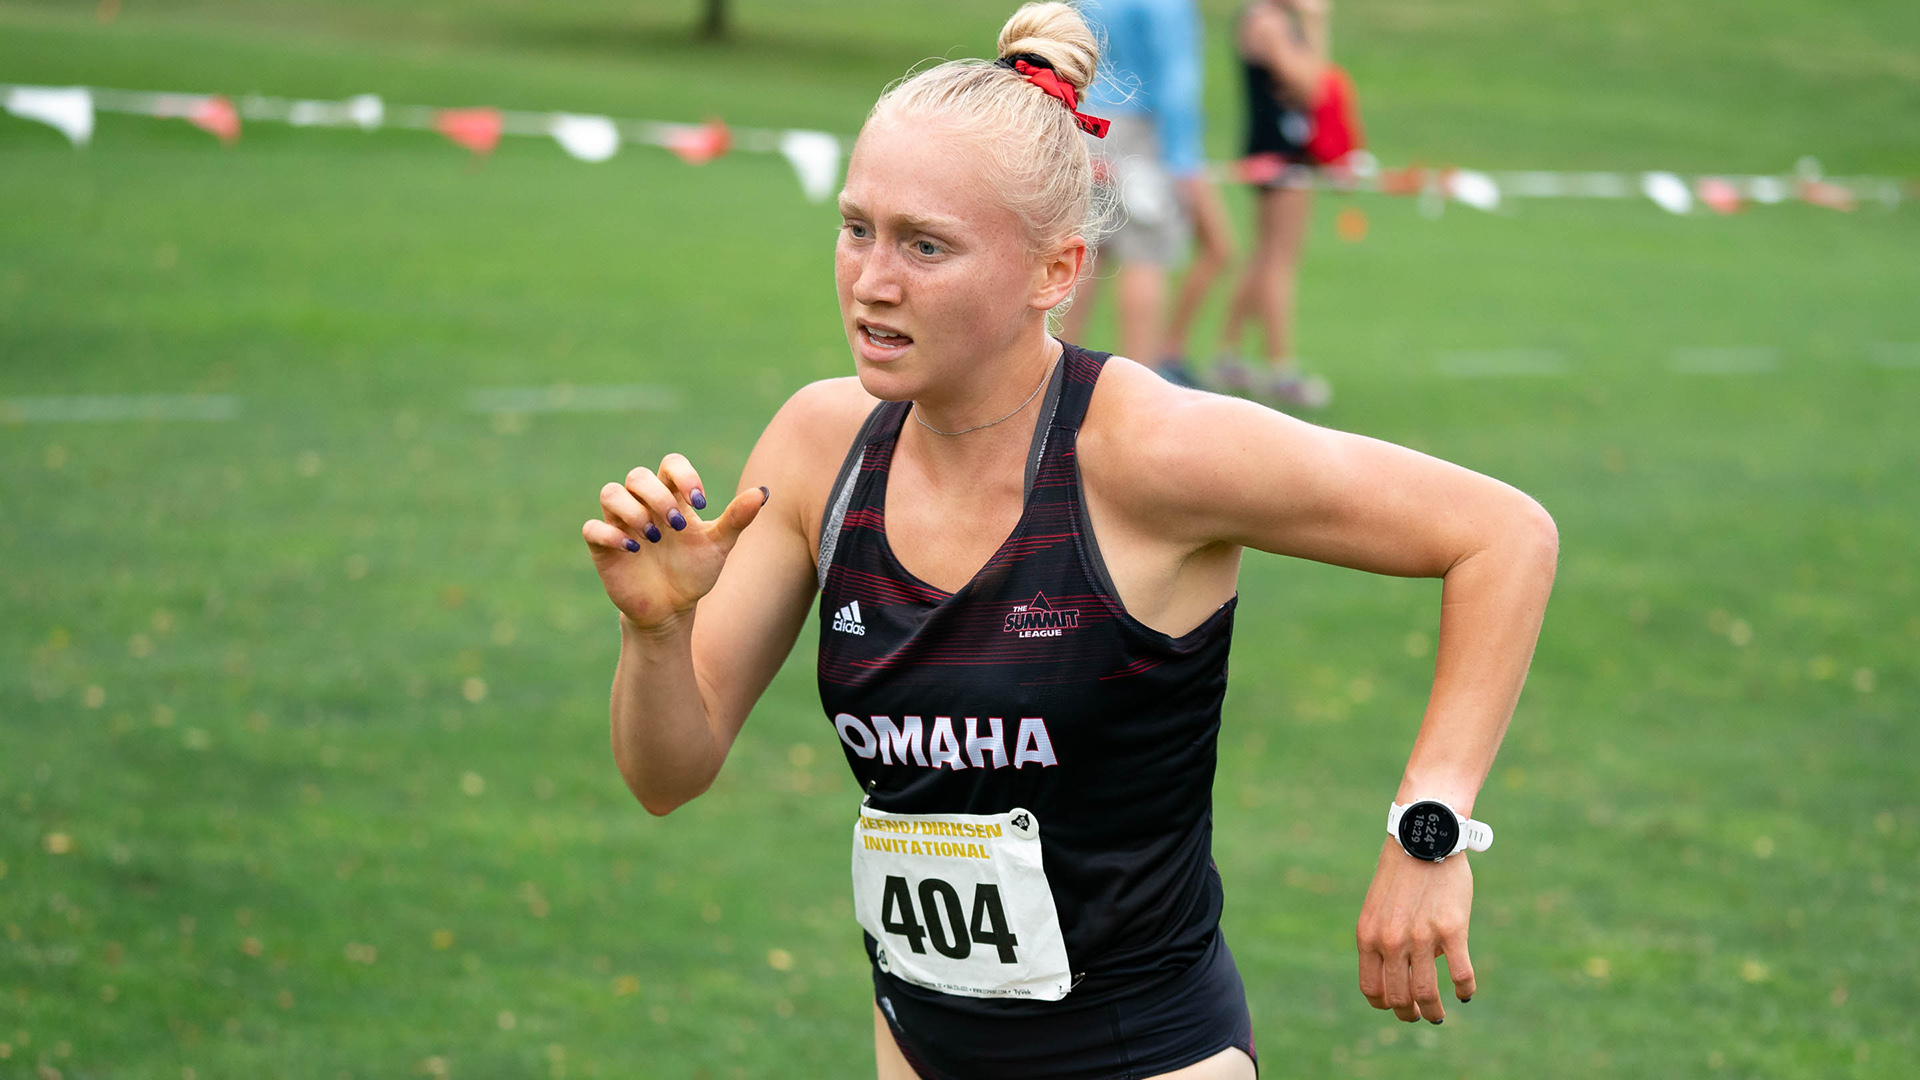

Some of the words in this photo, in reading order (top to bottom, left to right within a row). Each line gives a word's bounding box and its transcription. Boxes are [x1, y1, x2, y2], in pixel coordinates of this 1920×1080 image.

[1003, 608, 1080, 633] SUMMIT
[1013, 605, 1028, 613] THE
[1019, 629, 1063, 638] LEAGUE
[834, 712, 1059, 771] OMAHA
[1411, 814, 1425, 843] 18:29
[1424, 813, 1439, 843] 6:24
[863, 835, 990, 859] INVITATIONAL
[881, 875, 1019, 964] 404
